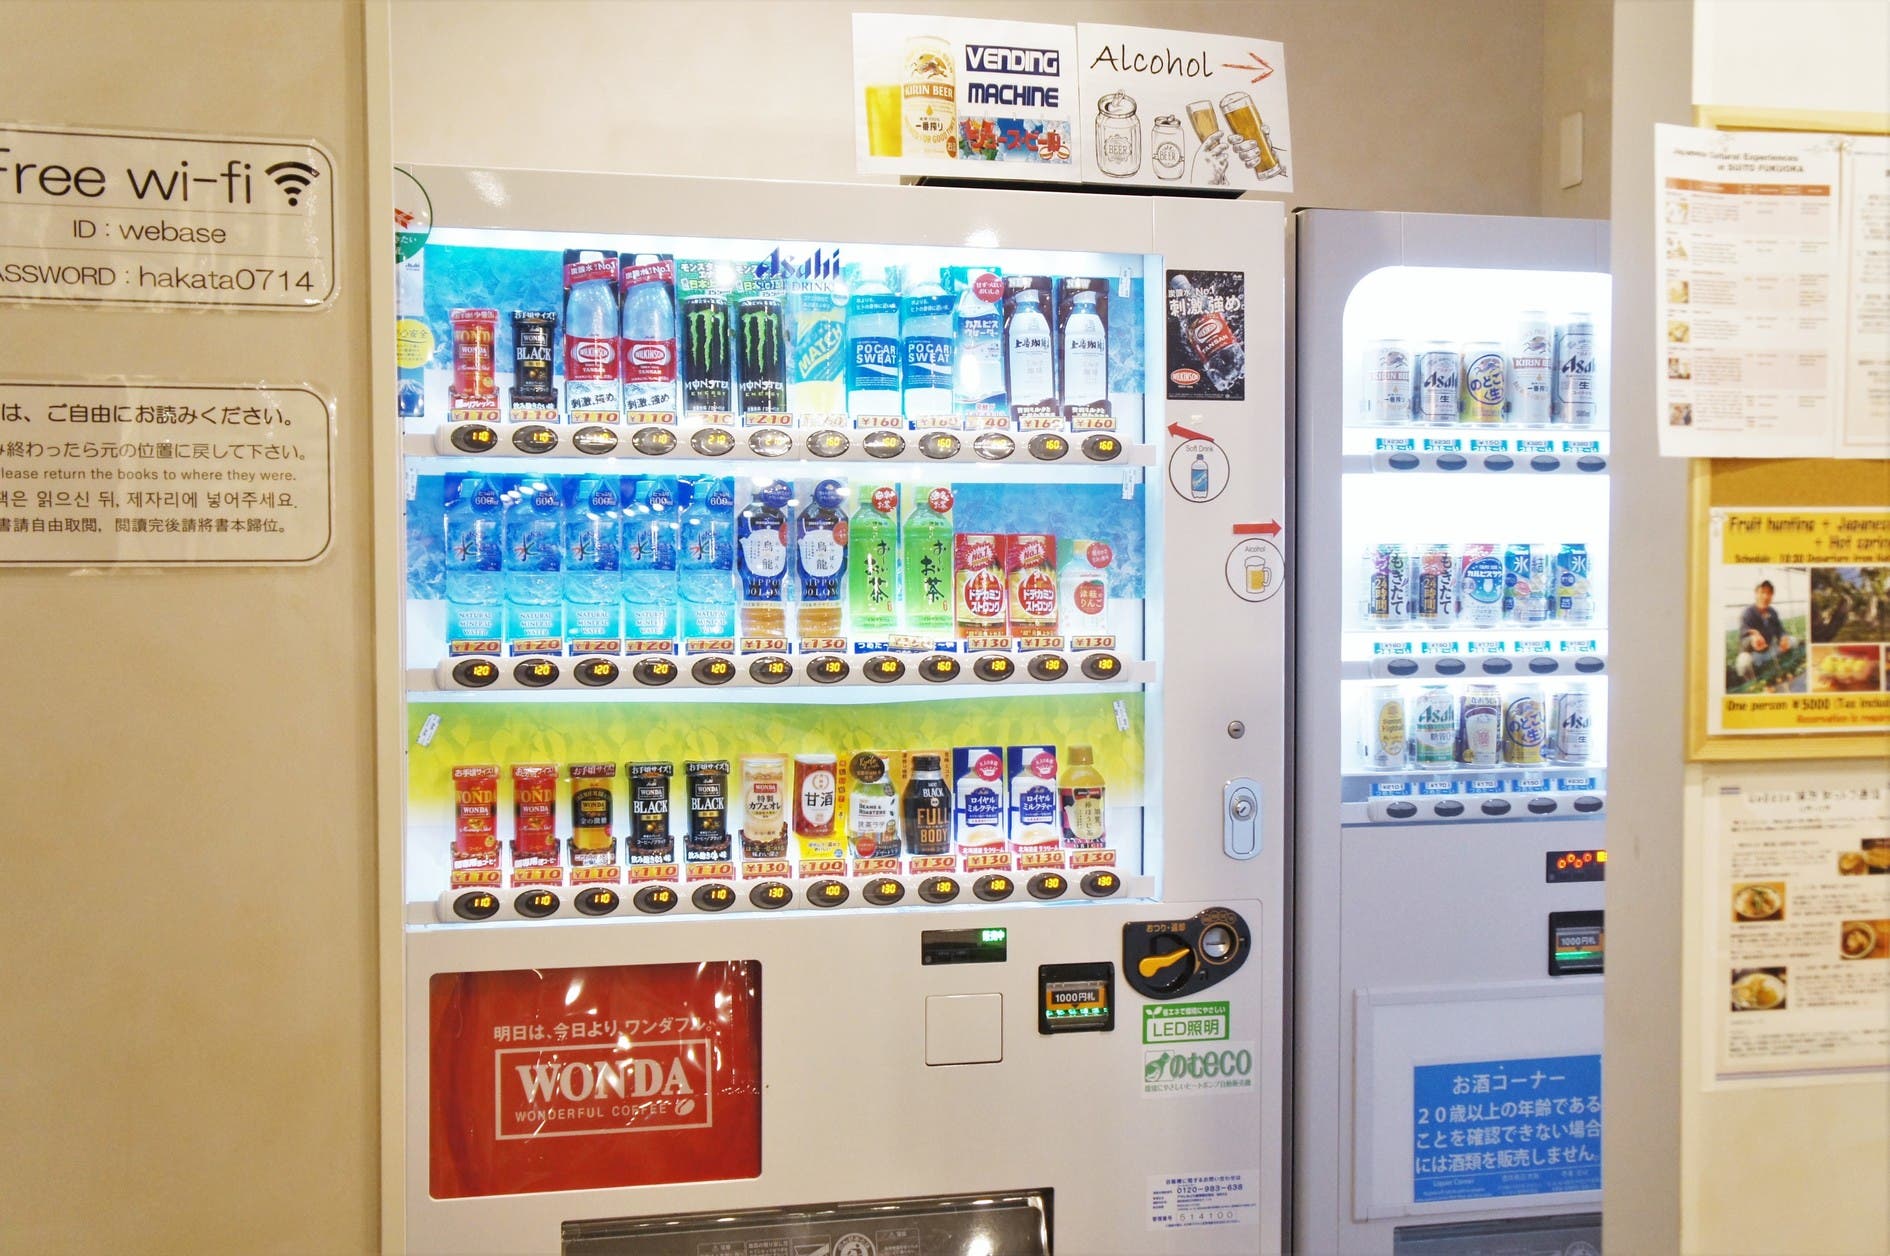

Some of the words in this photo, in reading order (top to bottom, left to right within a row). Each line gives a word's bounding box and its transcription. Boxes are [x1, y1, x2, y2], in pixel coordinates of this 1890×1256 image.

[965, 45, 1060, 76] VENDING
[1090, 44, 1214, 78] Alcohol
[904, 84, 930, 97] KIRIN
[932, 84, 954, 98] BEER
[968, 82, 1059, 108] MACHINE
[127, 160, 252, 204] wi-fi
[119, 220, 226, 243] webase
[755, 246, 840, 279] Asahi
[0, 263, 115, 286] SSWORD
[139, 267, 314, 292] hakata0714
[516, 347, 552, 361] BLACK
[798, 324, 843, 379] MATCH
[856, 353, 897, 365] SWEAT
[908, 353, 950, 364] SWEAT
[1515, 358, 1542, 367] KIRIN
[1579, 381, 1590, 390] 生
[1440, 395, 1450, 403] 生
[2, 403, 292, 426] は、ご自由にお読みください。
[454, 410, 498, 421] ¥110
[512, 410, 557, 421] ¥110
[574, 412, 618, 423] ¥110
[630, 413, 673, 424] ¥110
[862, 417, 900, 427] ¥160
[1076, 418, 1113, 428] ¥160
[0, 441, 306, 462] 終わったら元の位置に戻して下さい。
[44, 470, 86, 480] return
[91, 468, 113, 481] the
[117, 469, 158, 481] books
[163, 470, 176, 481] to
[181, 469, 222, 481] where
[227, 470, 255, 484] they
[260, 472, 297, 482] were.
[37, 491, 91, 509] 읽으신
[126, 491, 198, 509] 제자리에
[1729, 516, 1762, 531] Fruit
[1767, 516, 1815, 532] hunting
[1829, 535, 1851, 548] Hot
[1513, 557, 1529, 573] 氷
[1571, 556, 1586, 573] 氷
[969, 589, 1001, 600] ドデカミン
[1023, 589, 1054, 600] ドデカミン
[971, 601, 1001, 612] ストロング
[1025, 601, 1053, 612] ストロング
[459, 611, 491, 619] NATURAL
[576, 611, 608, 619] NATURAL
[454, 641, 499, 651] ¥120
[516, 640, 560, 650] ¥120
[575, 640, 618, 651] ¥120
[627, 640, 671, 651] ¥120
[690, 640, 732, 650] ¥120
[744, 639, 784, 649] ¥130
[803, 639, 845, 649] ¥130
[972, 638, 1009, 648] ¥130
[1024, 637, 1060, 648] ¥130
[1076, 637, 1112, 648] ¥130
[534, 664, 551, 675] 120
[594, 664, 610, 675] 120
[768, 662, 784, 673] 130
[826, 662, 841, 673] 130
[1098, 659, 1113, 670] 130
[1728, 700, 1746, 711] One
[1752, 701, 1788, 712] person
[922, 787, 944, 798] BLACK
[690, 797, 725, 811] BLACK
[804, 791, 834, 807] 甘酒
[463, 806, 489, 814] WONDA
[633, 800, 669, 814] BLACK
[748, 801, 781, 810] カフェオレ
[917, 807, 949, 826] FULL
[920, 829, 948, 843] BODY
[971, 854, 1009, 865] ¥130
[1026, 852, 1062, 863] ¥130
[1074, 851, 1114, 862] ¥130
[746, 862, 786, 873] ¥130
[801, 861, 843, 871] ¥100
[855, 859, 896, 869] ¥130
[913, 857, 955, 868] ¥130
[517, 869, 561, 879] ¥110
[574, 867, 618, 878] ¥110
[633, 865, 677, 876] ¥110
[688, 863, 731, 875] ¥110
[454, 871, 499, 882] ¥110
[936, 881, 951, 893] 130
[990, 879, 1006, 891] 130
[1044, 877, 1060, 888] 130
[768, 887, 784, 898] 130
[474, 895, 491, 908] 110
[534, 894, 552, 906] 110
[594, 893, 611, 904] 110
[1055, 992, 1096, 1003] 1000円札
[1153, 1019, 1220, 1037] LED照明
[515, 1056, 694, 1104] WONDA
[1453, 1070, 1566, 1095] お酒コーナー
[515, 1105, 604, 1123] WONDERFUL
[611, 1103, 667, 1117] COFFEE
[1416, 1119, 1602, 1149] ことを確認できない場合
